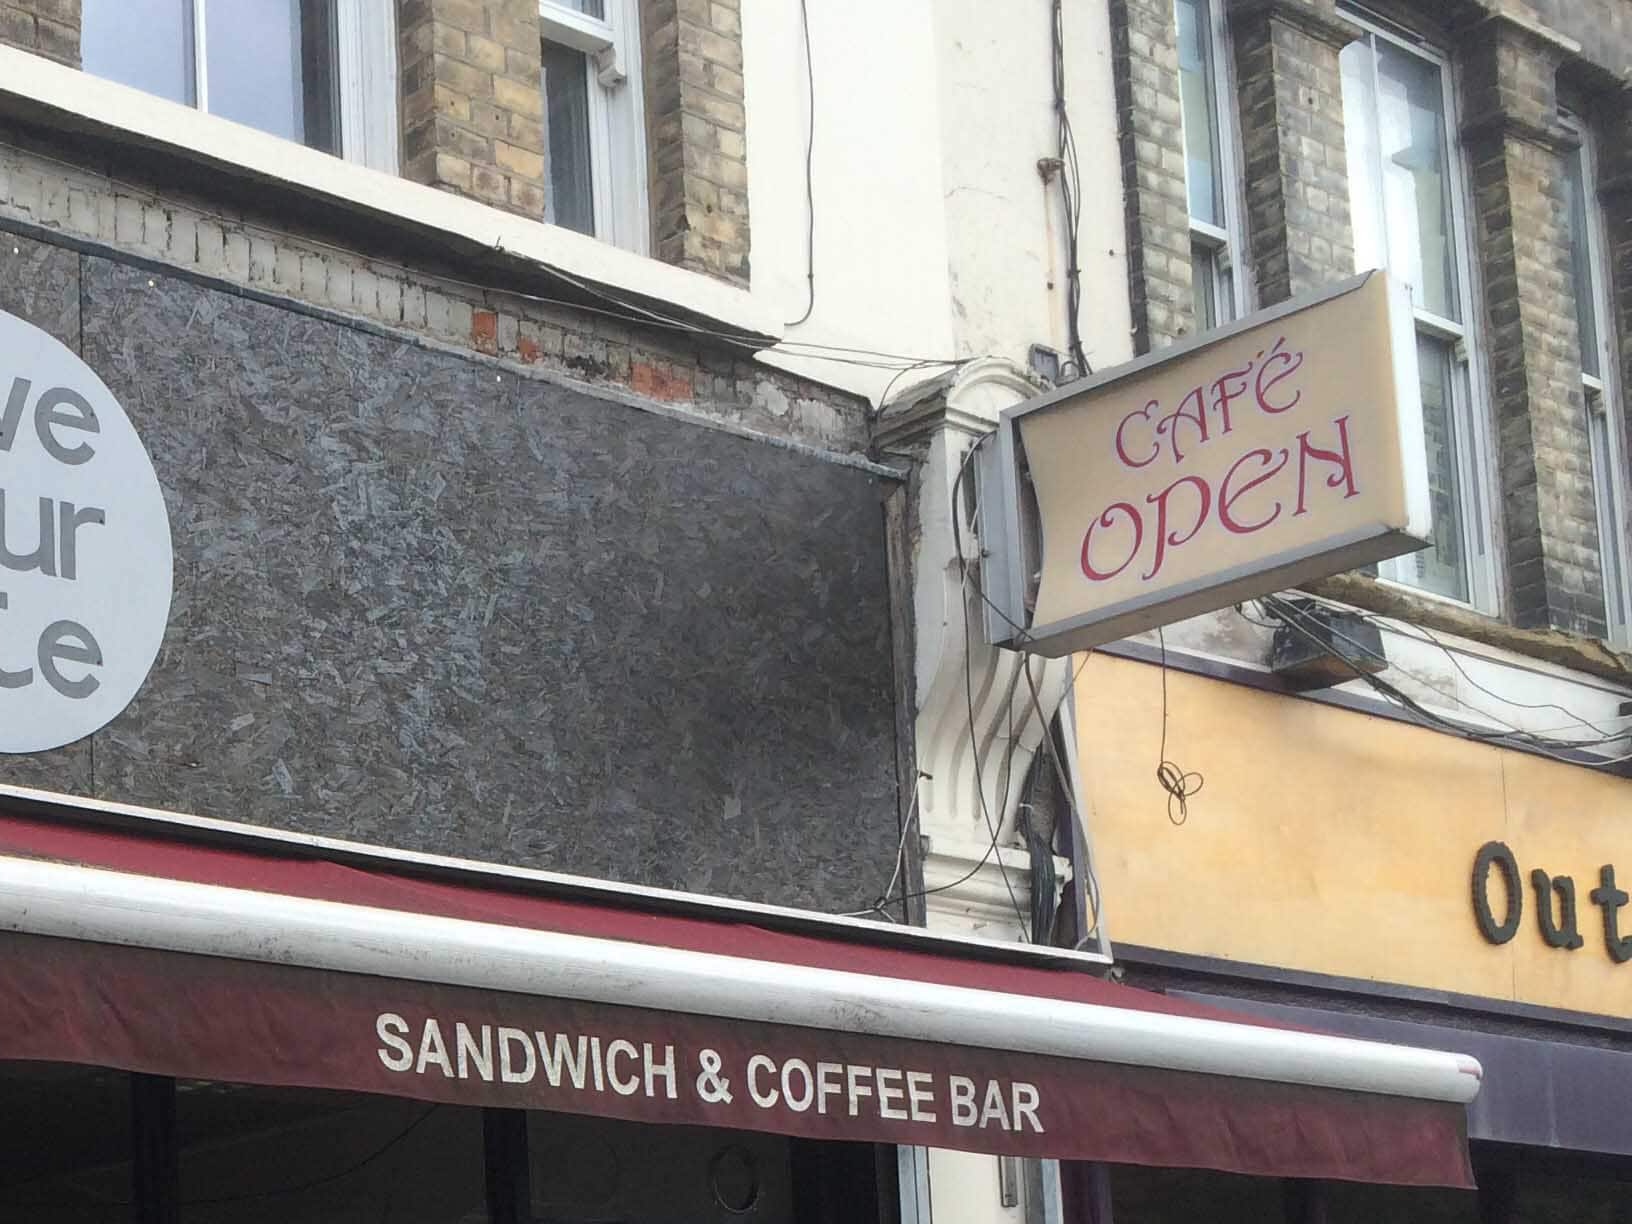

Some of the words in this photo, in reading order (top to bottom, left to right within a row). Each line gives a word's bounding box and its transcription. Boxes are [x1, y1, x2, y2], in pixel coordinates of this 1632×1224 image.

[1080, 415, 1359, 581] OPEN
[1471, 840, 1632, 964] Out
[375, 1012, 678, 1099] SANDWICH
[695, 1047, 734, 1105] &
[746, 1054, 937, 1123] COFFEE
[948, 1074, 1044, 1134] BAR
